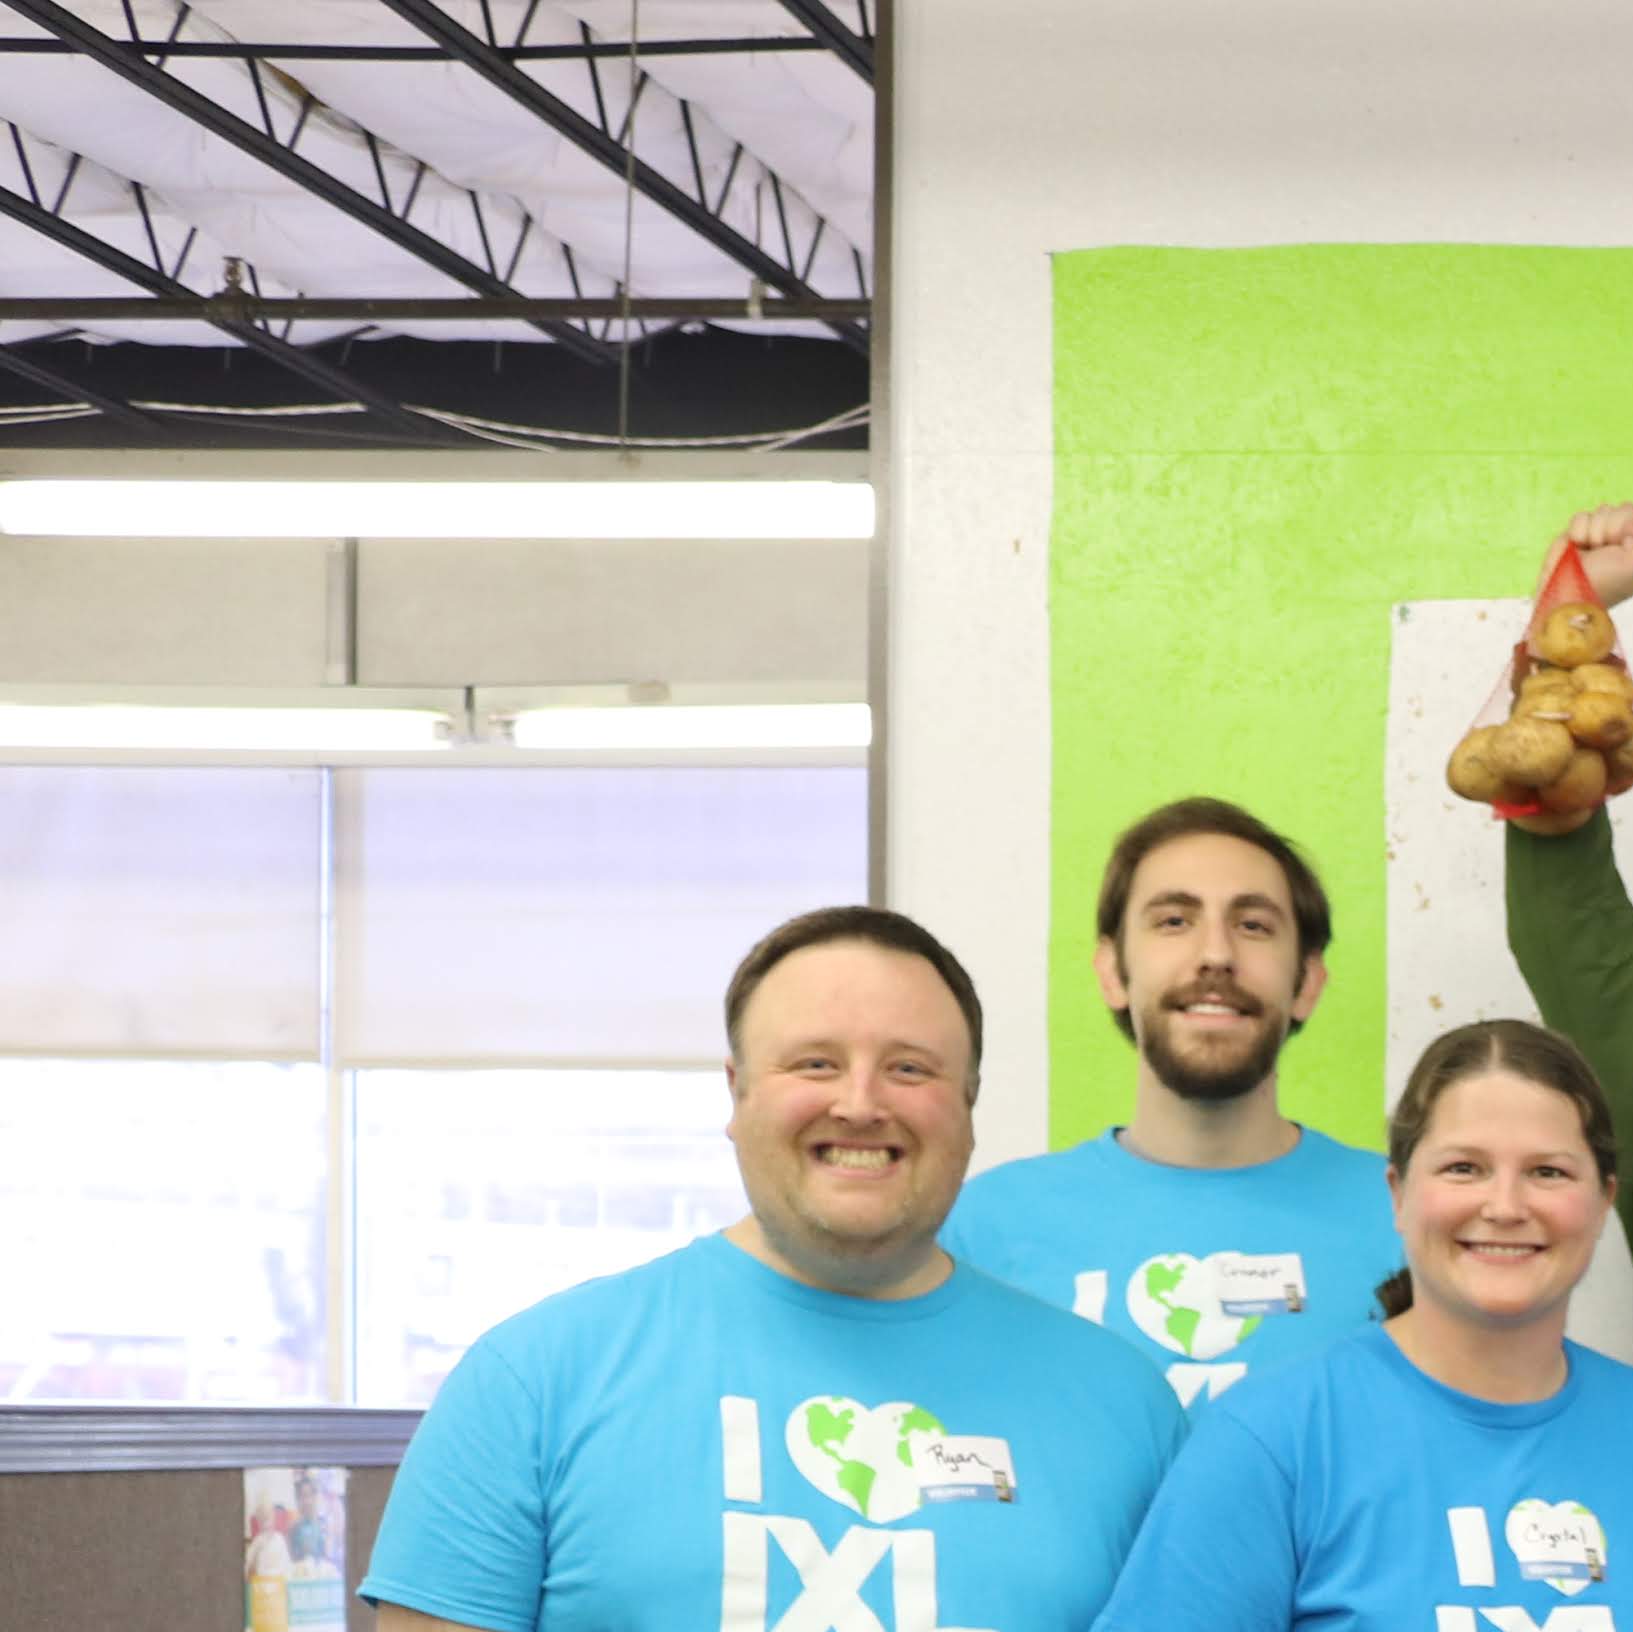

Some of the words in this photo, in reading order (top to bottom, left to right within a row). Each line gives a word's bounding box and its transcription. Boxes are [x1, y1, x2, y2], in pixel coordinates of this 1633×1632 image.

[719, 1395, 763, 1504] I
[926, 1443, 994, 1473] Ryan
[1446, 1505, 1497, 1589] I
